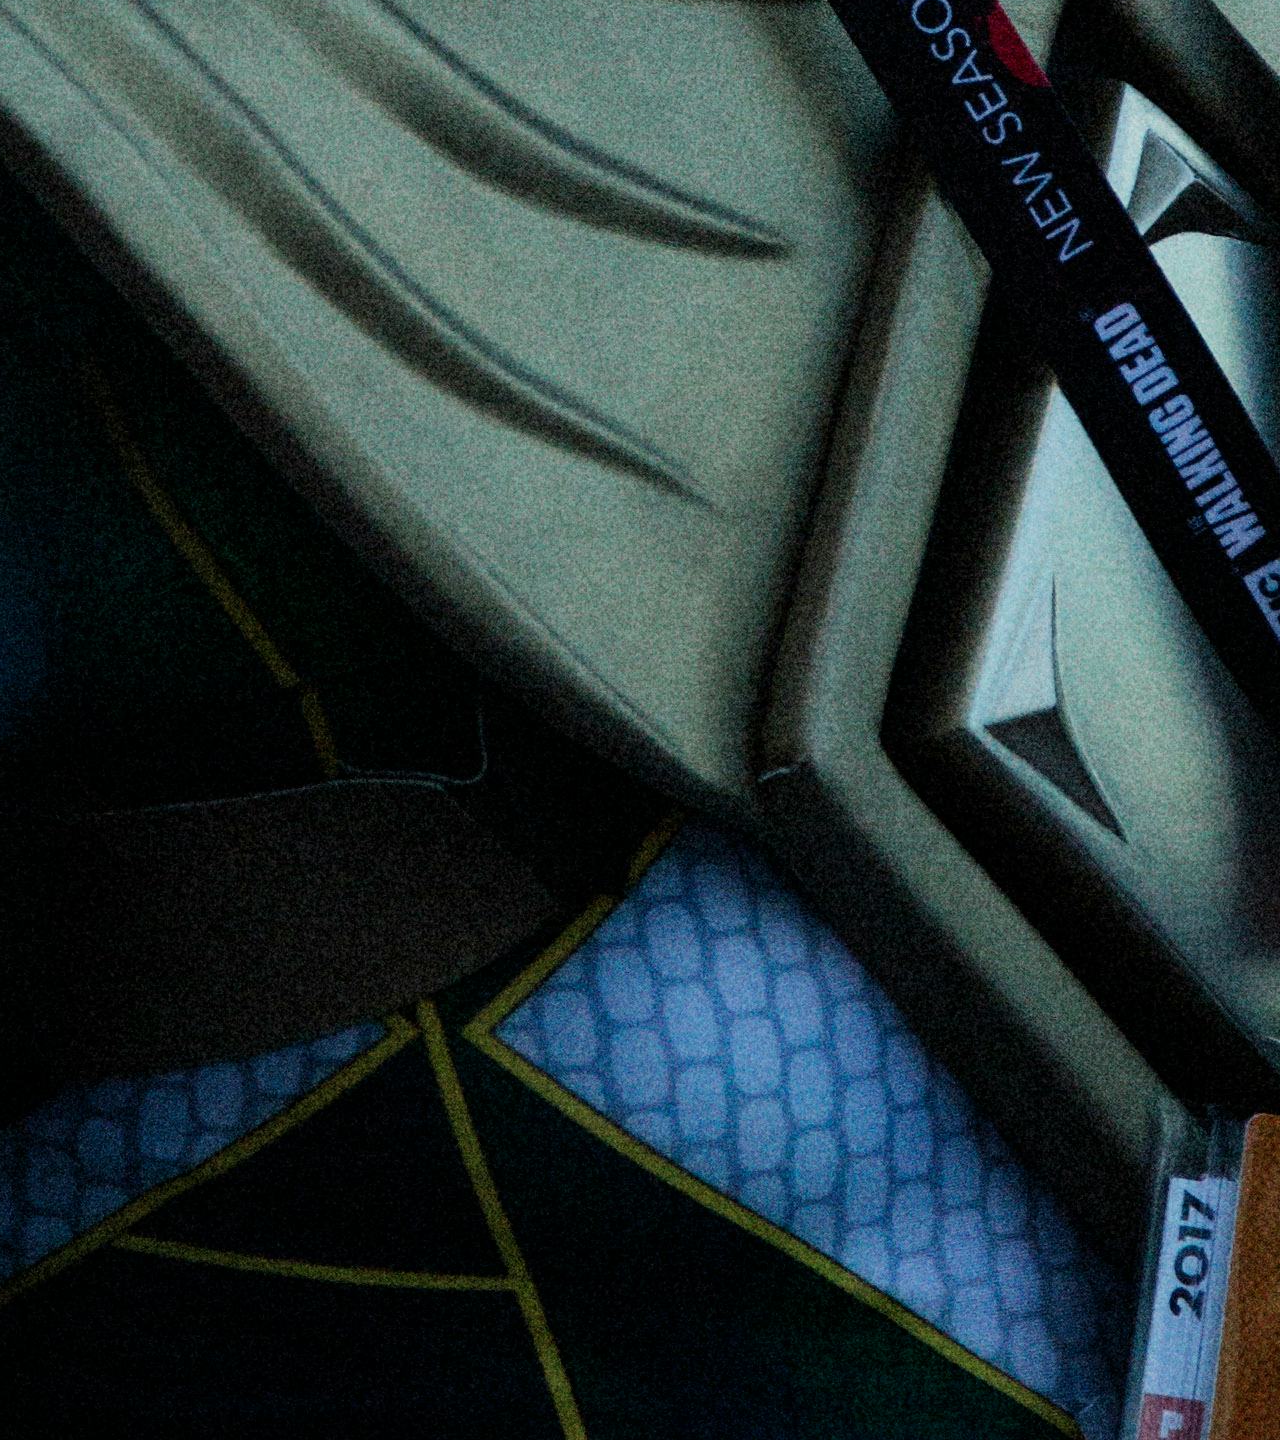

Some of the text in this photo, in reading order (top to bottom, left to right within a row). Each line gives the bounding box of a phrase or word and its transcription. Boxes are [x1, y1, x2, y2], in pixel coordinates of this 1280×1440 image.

[1001, 149, 1094, 265] NEW
[1091, 301, 1268, 562] WALKING DEAD
[1169, 1190, 1217, 1320] 2017
